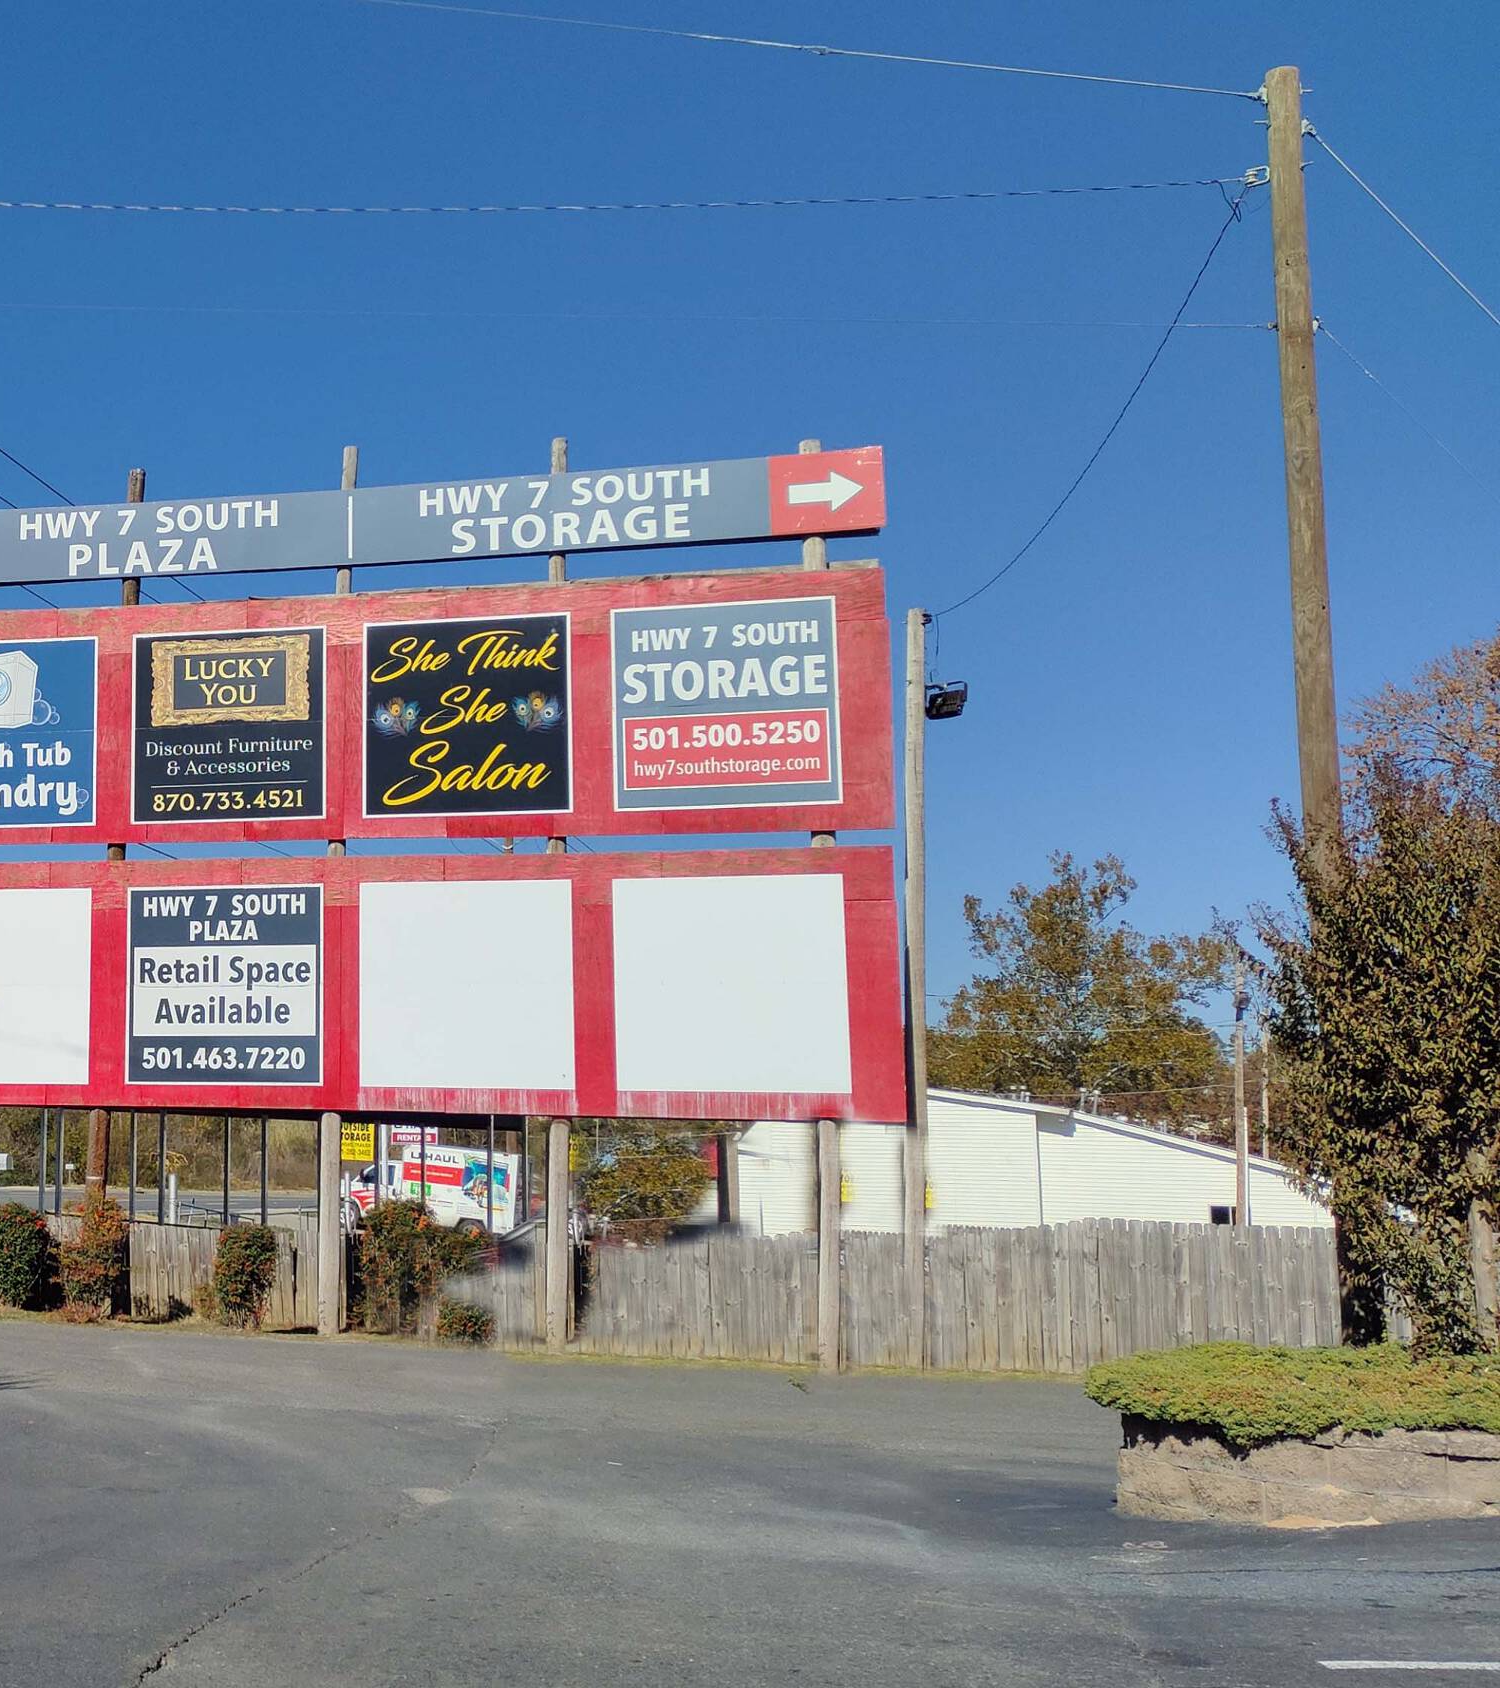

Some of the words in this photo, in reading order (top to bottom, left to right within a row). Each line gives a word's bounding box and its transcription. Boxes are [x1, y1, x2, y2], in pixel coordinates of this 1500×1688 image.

[419, 482, 508, 518] HWY
[528, 481, 549, 509] 7
[571, 467, 710, 507] SOUTH
[19, 510, 101, 541] HWY
[117, 509, 137, 536] 7
[156, 499, 279, 534] SOUTH
[451, 502, 691, 555] STORAGE
[68, 537, 218, 577] PLAZA
[632, 627, 691, 652] HWY
[703, 626, 718, 649] 7
[731, 620, 819, 648] SOUTH
[184, 656, 275, 682] LUCKY
[371, 635, 451, 684] She
[457, 629, 562, 676] Think
[623, 655, 828, 704] STORAGE
[200, 683, 257, 706] YOU
[419, 685, 506, 734] She
[145, 737, 223, 758] Discount
[228, 737, 313, 755] Furniture
[633, 720, 820, 751] 501.500.5250
[21, 741, 71, 767] Tub
[166, 760, 181, 776] &
[184, 757, 291, 775] Accessories
[633, 755, 821, 779] hwy7southstorage.com
[382, 741, 551, 807] Salon
[153, 789, 303, 813] 870.733.4521
[143, 896, 194, 918] HWY
[205, 895, 218, 916] 7
[231, 894, 306, 916] SOUTH
[189, 920, 258, 941] PLAZA
[139, 955, 220, 984] Retail
[229, 956, 311, 990] Space
[155, 996, 290, 1024] Available
[142, 1047, 306, 1070] 501.463.7220
[340, 1122, 370, 1131] UTSIDE
[397, 1134, 432, 1142] RENTAS
